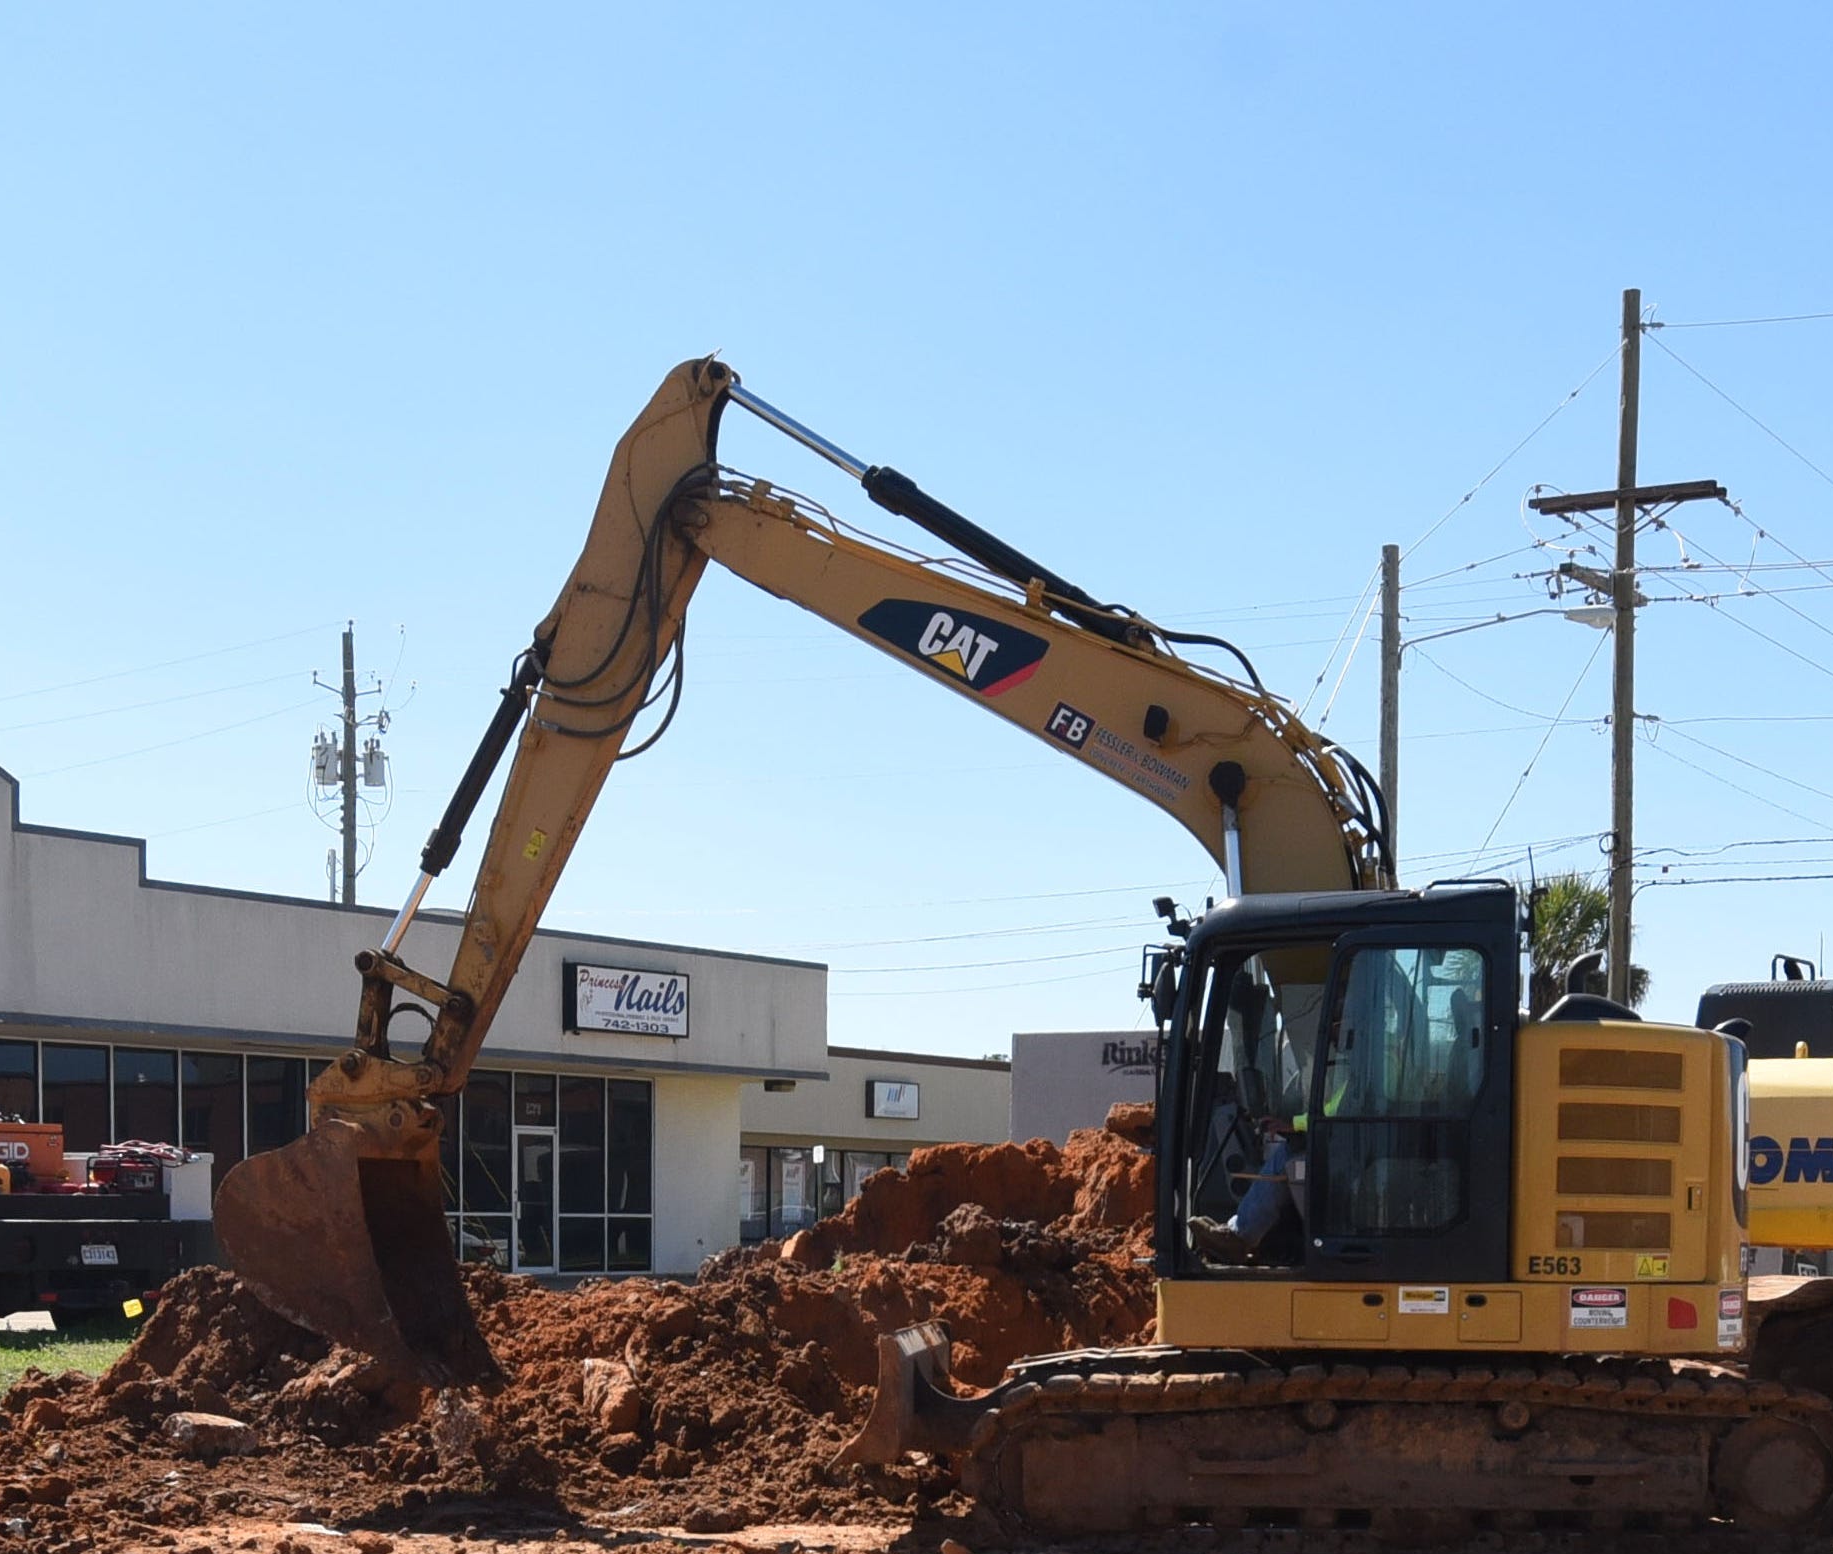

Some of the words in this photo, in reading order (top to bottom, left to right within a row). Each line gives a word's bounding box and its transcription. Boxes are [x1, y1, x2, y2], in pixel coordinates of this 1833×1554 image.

[918, 612, 999, 681] CAT
[1141, 754, 1190, 790] BOWMAN
[614, 974, 685, 1015] Nails
[602, 1018, 669, 1034] 742-1303
[1528, 1256, 1582, 1275] E563
[1579, 1294, 1620, 1302] DANGER
